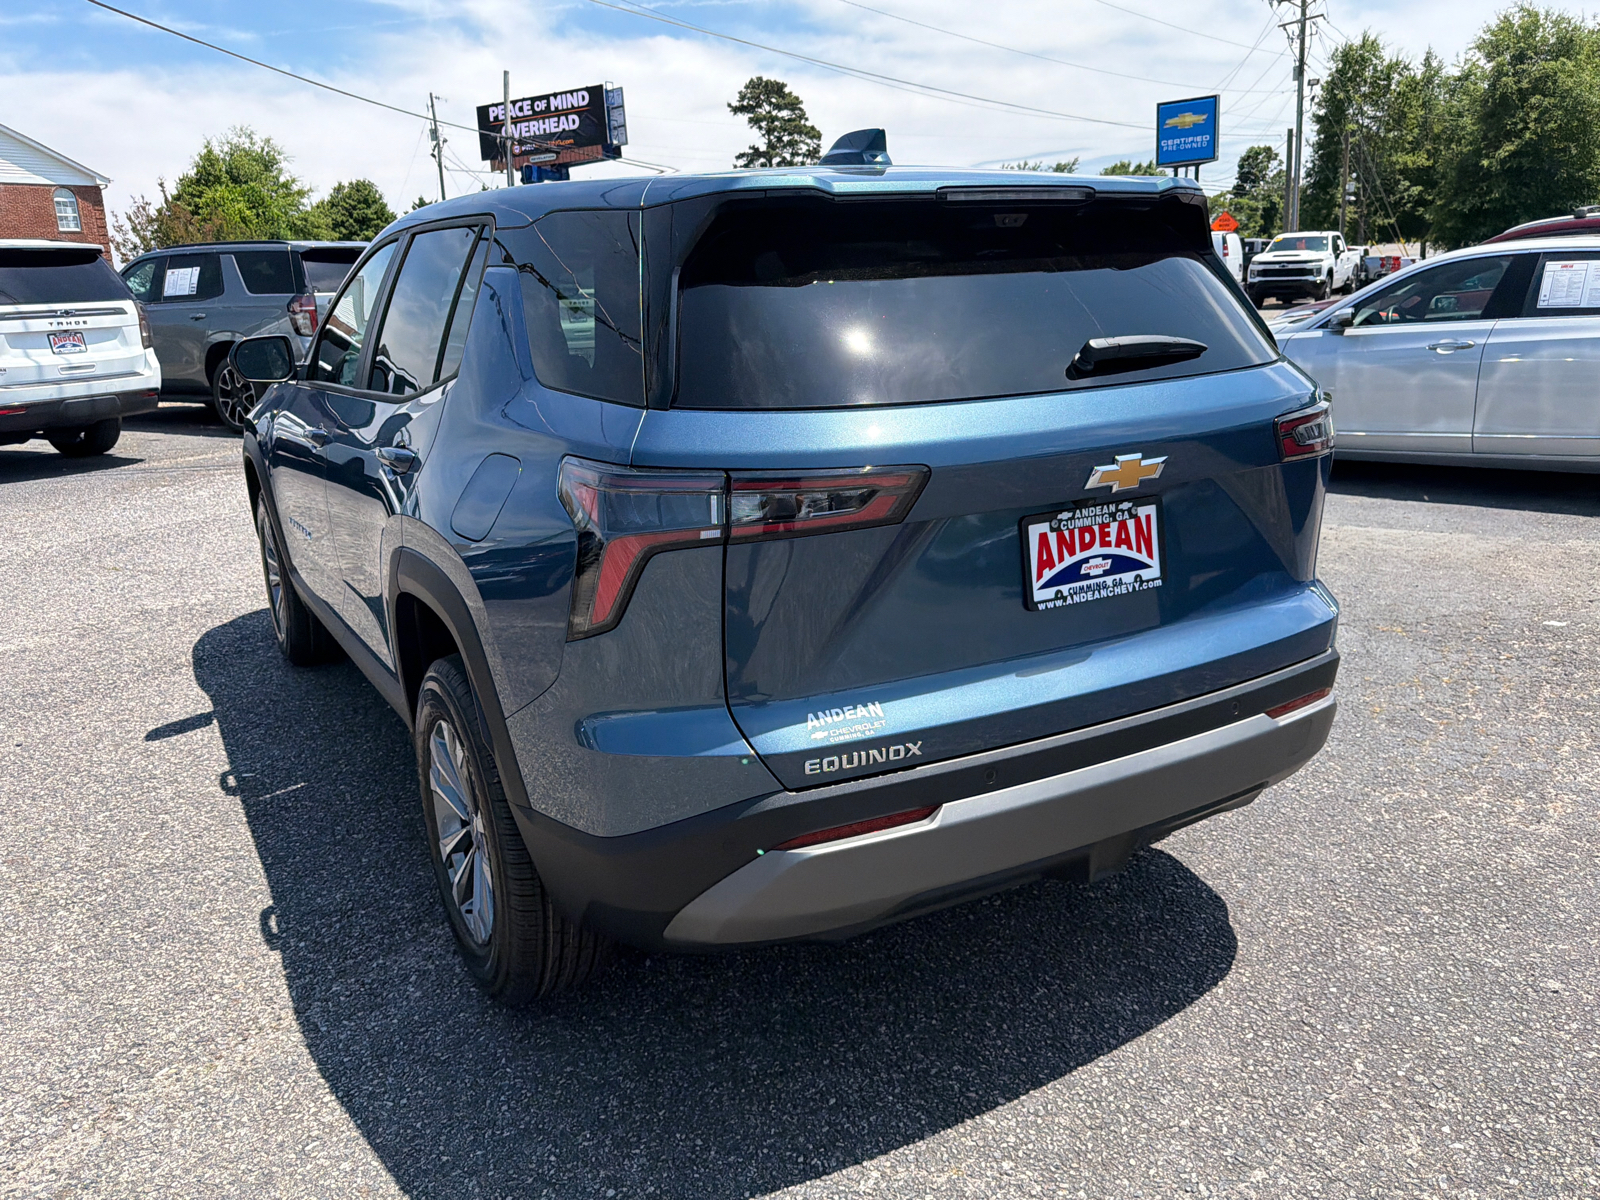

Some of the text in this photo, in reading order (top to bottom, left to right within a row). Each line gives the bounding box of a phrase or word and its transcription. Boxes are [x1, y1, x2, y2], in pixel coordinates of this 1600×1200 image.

[488, 90, 590, 122] PEACE OF MIND
[1161, 134, 1210, 147] CERTIFIED
[1162, 141, 1208, 152] PRE-OWNED
[48, 320, 88, 328] TAHOE
[52, 335, 84, 348] ANDEAN
[1074, 503, 1116, 519] ANDEAN
[1060, 510, 1130, 531] CUMMING, GA
[1036, 513, 1154, 584] ANDEAN
[1083, 561, 1111, 572] CHEVROLET
[1037, 578, 1163, 611] www.ANDEANCHEVY.com
[807, 701, 885, 731] ANDEAN
[829, 719, 887, 737] CHEVROLET
[829, 732, 865, 743] CUMMING,
[804, 740, 923, 775] EQUINOX
